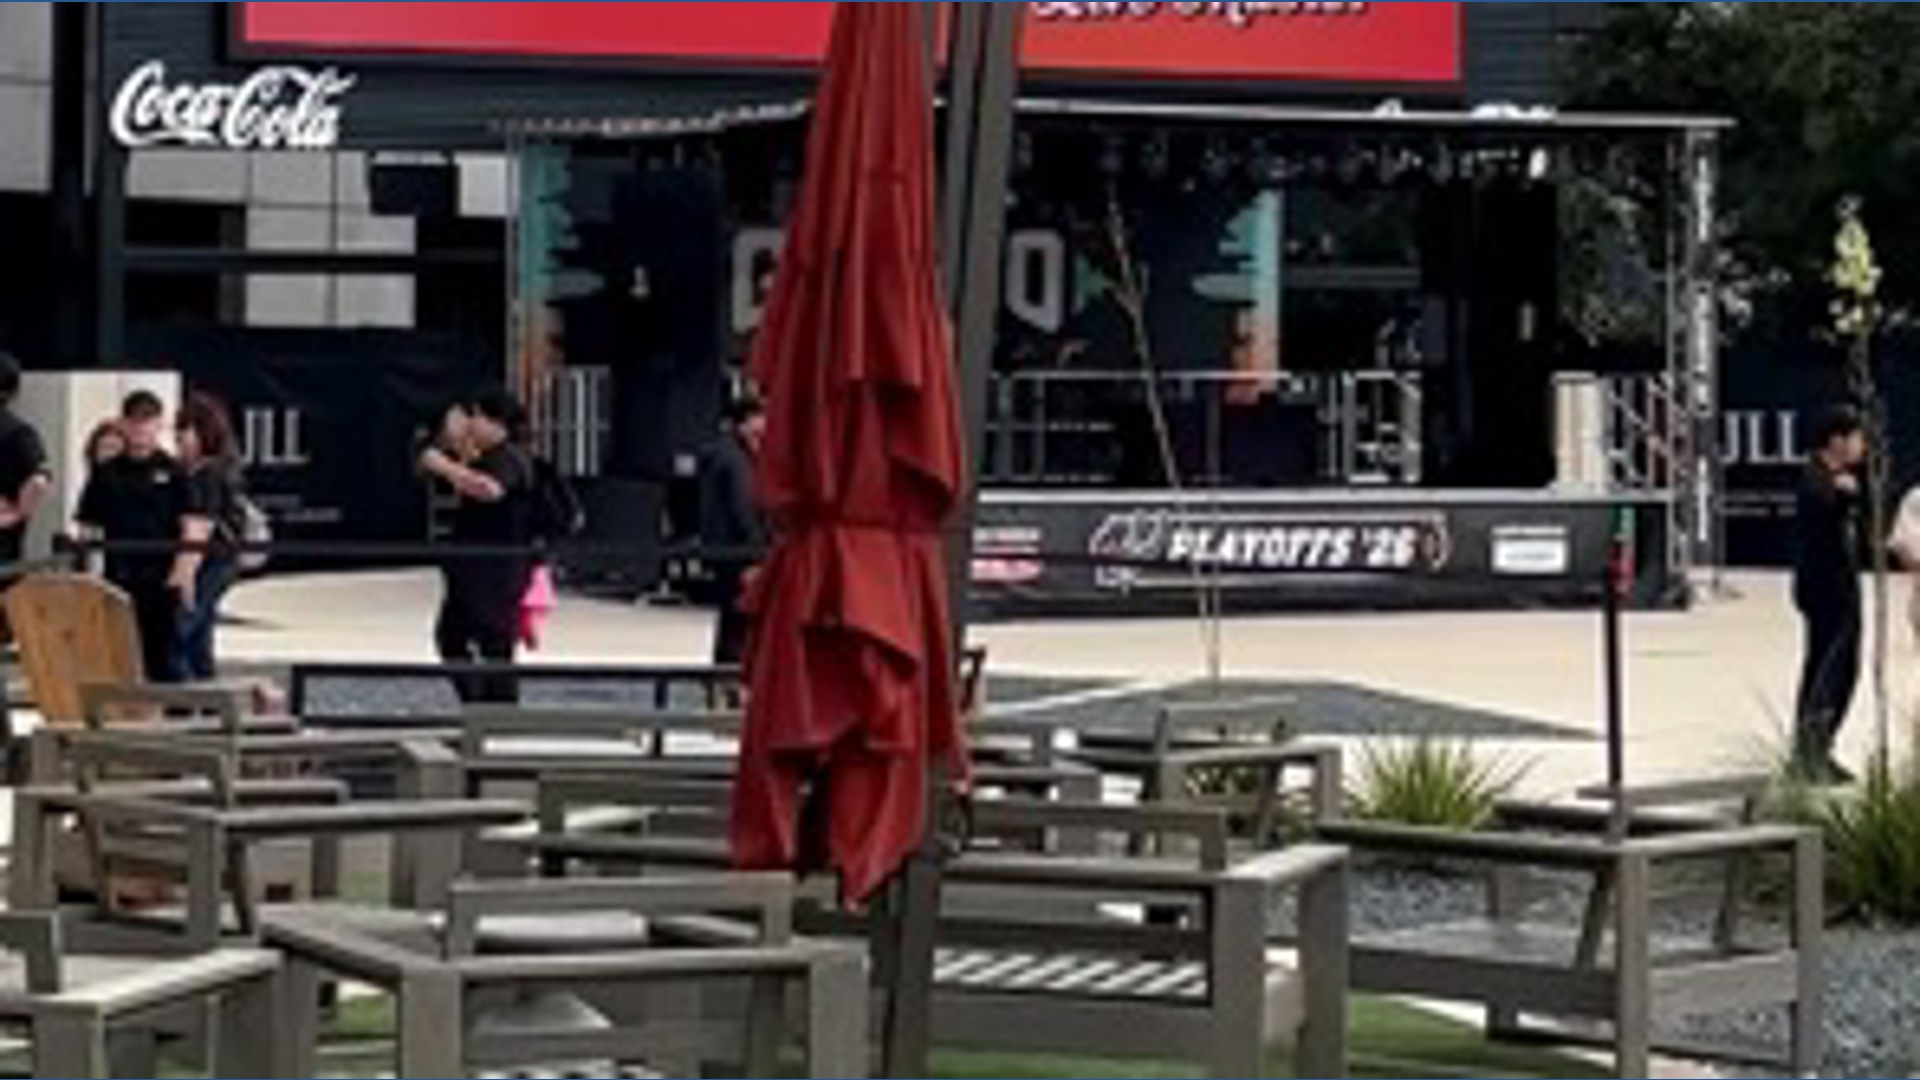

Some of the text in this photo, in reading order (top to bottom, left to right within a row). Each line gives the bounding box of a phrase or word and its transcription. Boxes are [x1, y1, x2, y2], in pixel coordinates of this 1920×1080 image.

[240, 408, 312, 466] JLL
[1713, 410, 1811, 465] JLL
[1167, 526, 1355, 568] PLAYOFFS
